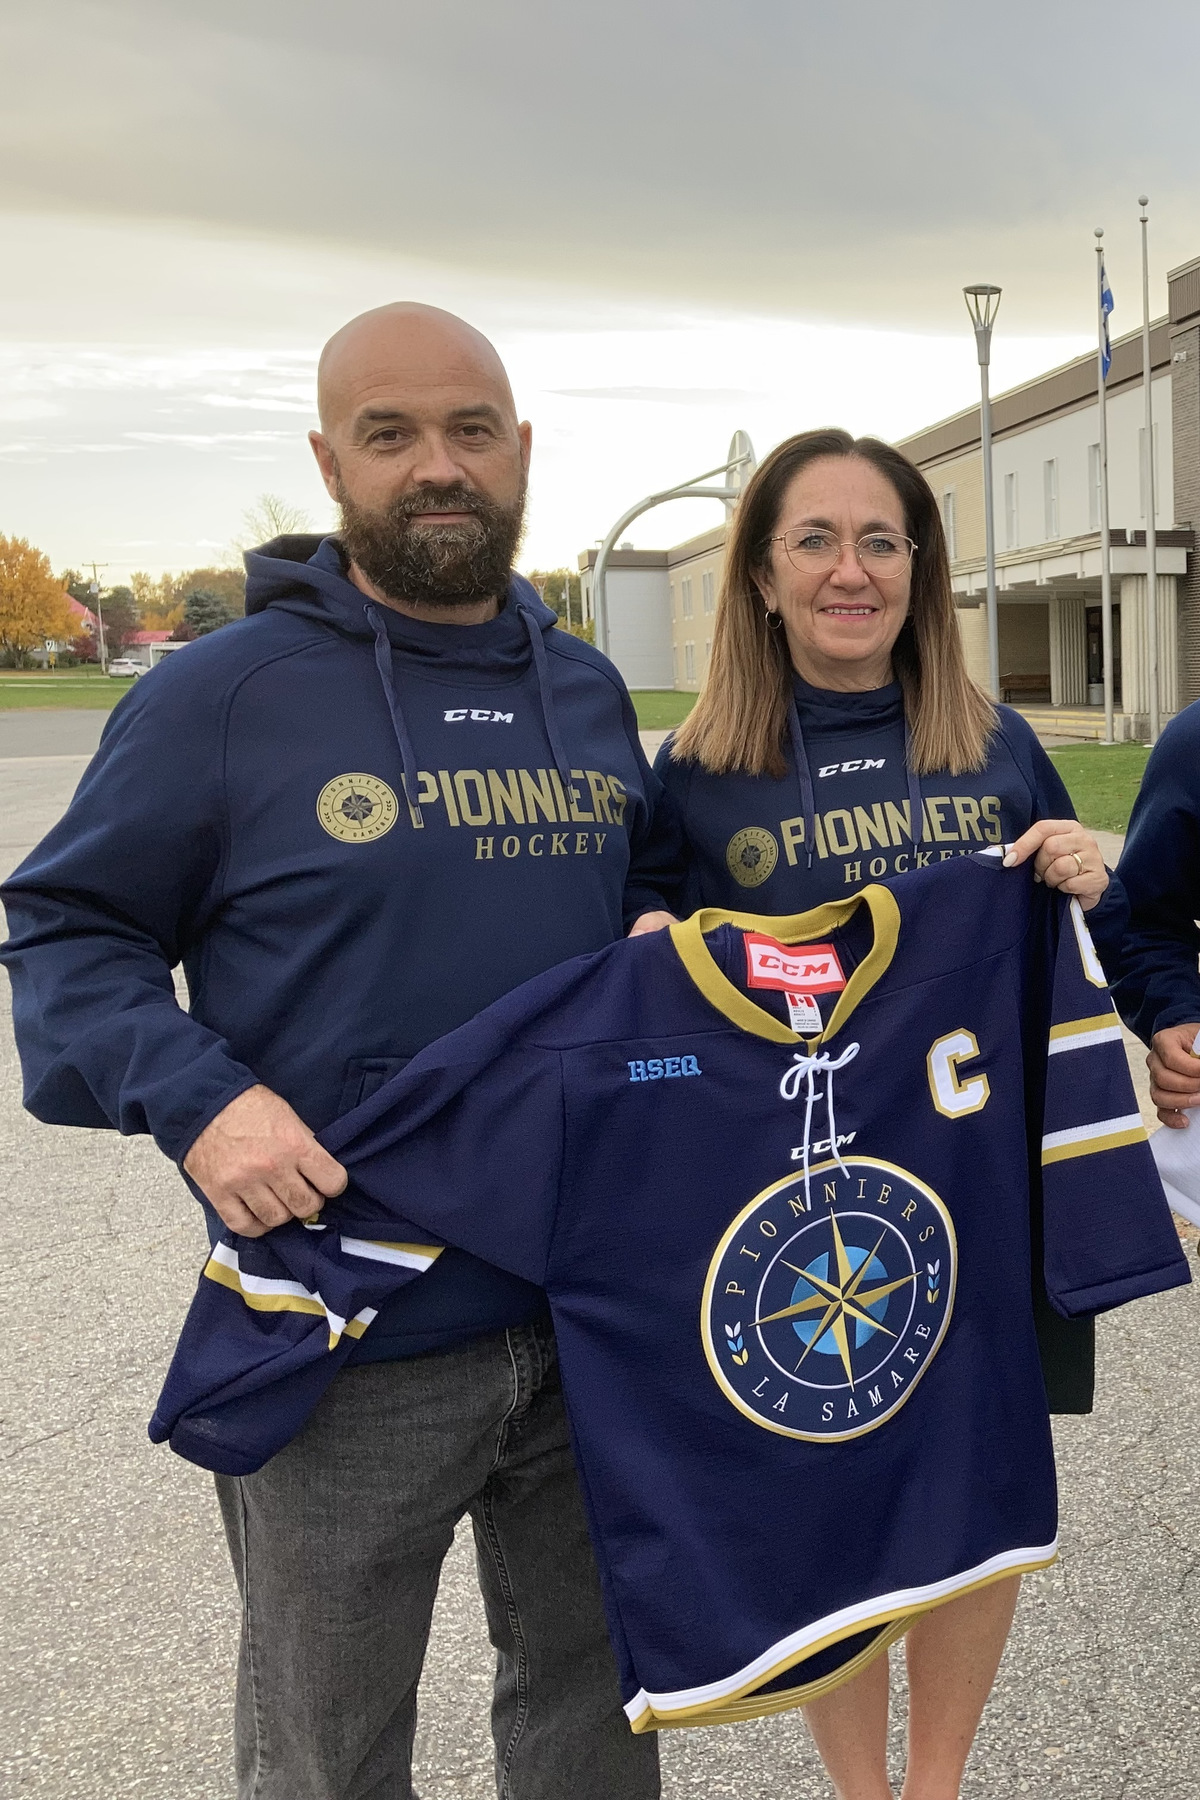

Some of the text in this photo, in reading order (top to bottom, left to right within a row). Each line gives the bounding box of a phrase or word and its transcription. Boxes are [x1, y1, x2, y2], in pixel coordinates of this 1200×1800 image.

[444, 709, 514, 723] CCM
[818, 758, 886, 778] CCM
[401, 769, 627, 828] PIONNIERS
[475, 833, 607, 860] HOCKEY
[780, 796, 1002, 866] PIONNIERS
[844, 850, 973, 884] HOCK
[759, 954, 830, 977] CCM
[627, 1055, 702, 1082] RSEQ
[927, 1028, 990, 1119] C
[791, 1131, 857, 1160] CCM
[725, 1178, 935, 1296] PIONNIERS
[752, 1324, 931, 1421] LA SAMARE
